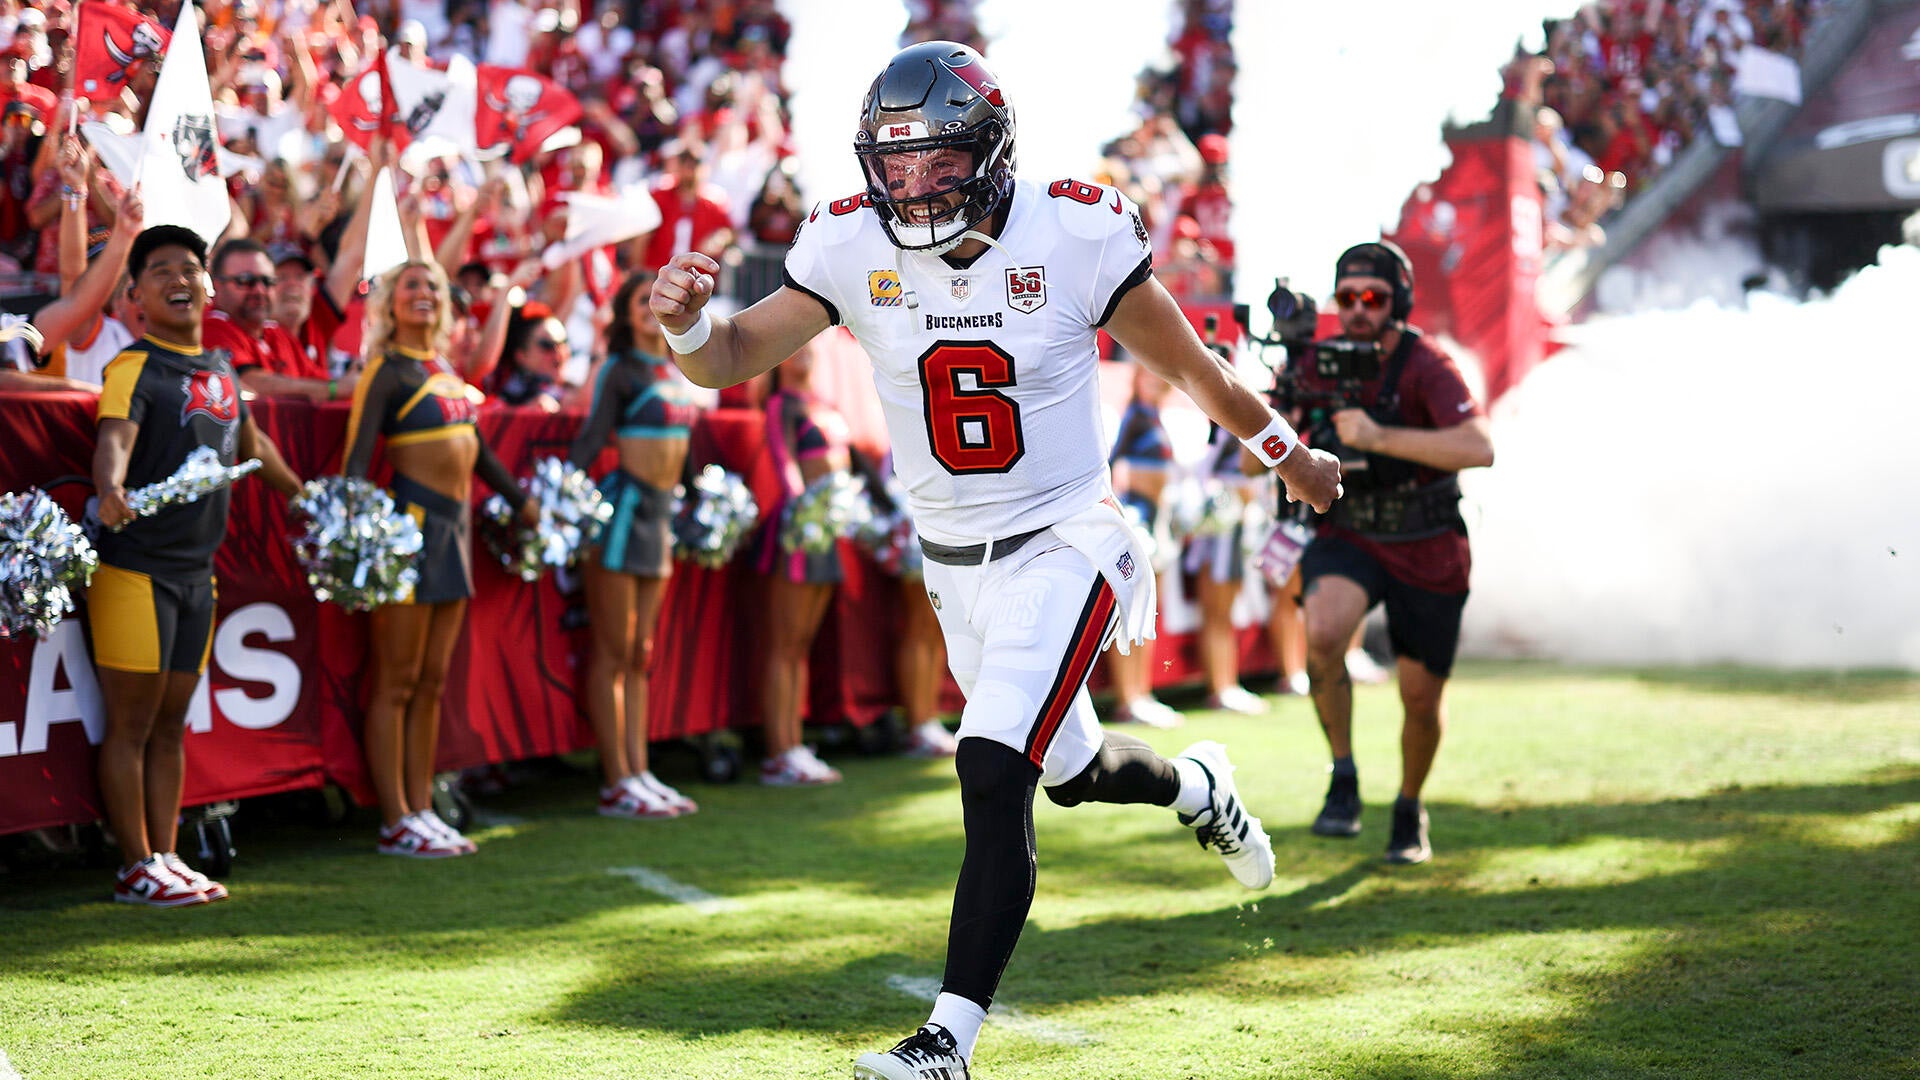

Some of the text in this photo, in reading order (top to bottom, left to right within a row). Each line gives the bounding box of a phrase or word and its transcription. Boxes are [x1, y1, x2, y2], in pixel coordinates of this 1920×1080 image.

[889, 125, 911, 138] BUCS
[1047, 178, 1103, 205] 6
[870, 271, 902, 299] C
[925, 312, 1003, 332] BUCCANEERS
[917, 339, 1025, 476] 6
[1262, 435, 1287, 460] 6
[0, 602, 302, 757] AS
